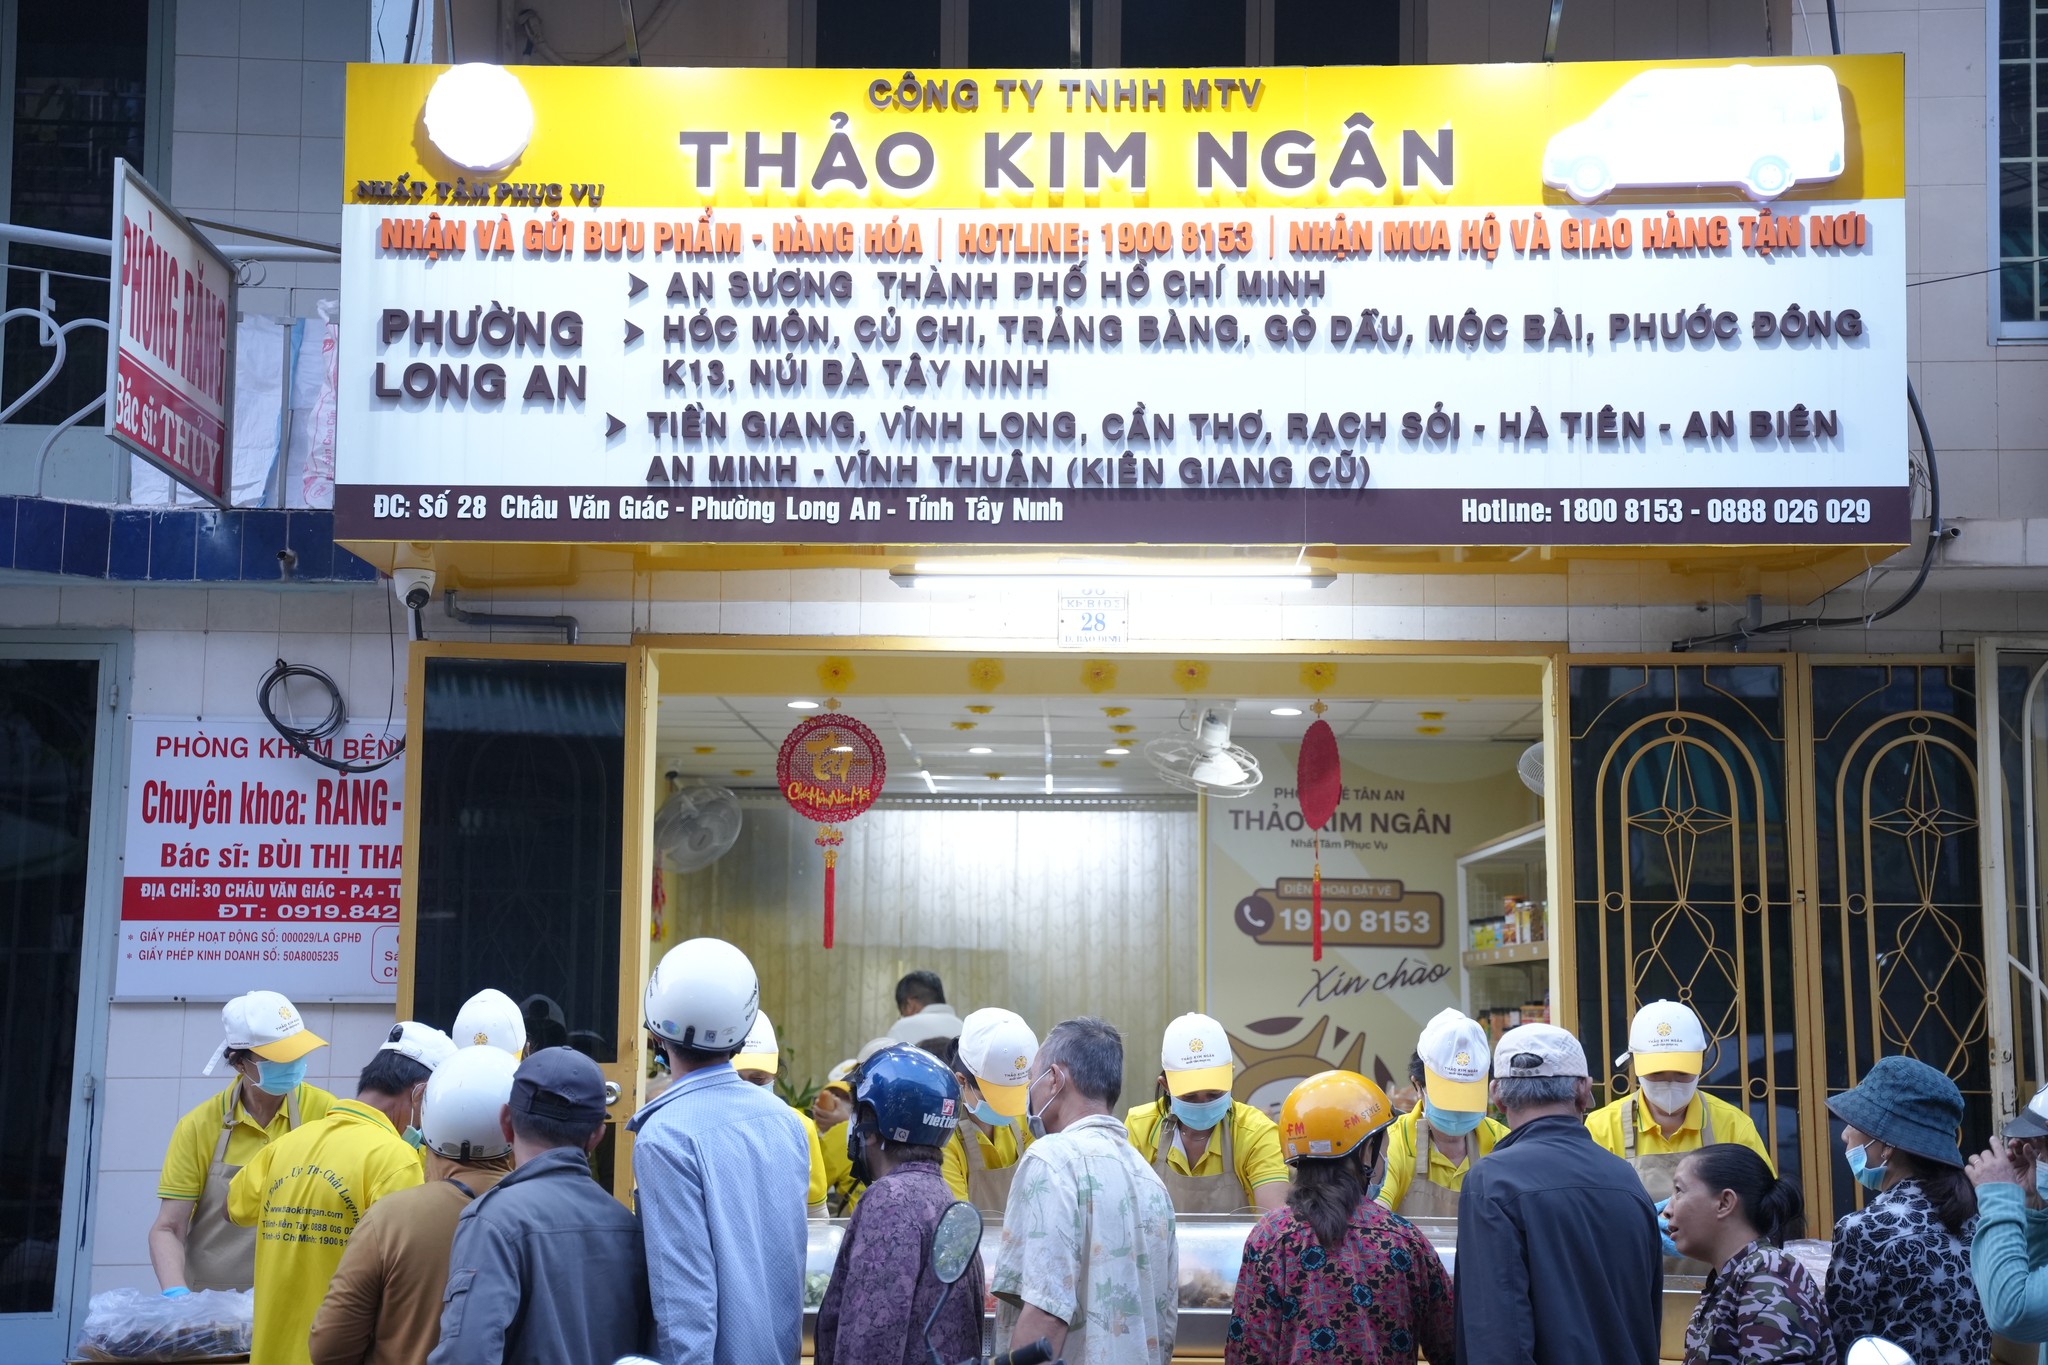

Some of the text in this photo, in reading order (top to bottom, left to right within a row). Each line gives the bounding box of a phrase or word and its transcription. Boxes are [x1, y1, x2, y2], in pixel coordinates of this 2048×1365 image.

[868, 71, 1262, 112] CÔNG TY TNHH MTV
[679, 111, 1454, 190] THẢO KIM NGÂN
[356, 172, 605, 206] NHẤT TÂM PHỤC VỤ
[381, 205, 1866, 260] NHẬN VÀ GỬI BƯU PHẨM HÀNG HÓA HOTLINE: 1900 8153 NHẬN MUA HỘ VÀ GIAO HÀNG TẬN NƠI
[665, 258, 1326, 300] AN SƯƠNG THÀNH PHỐ HỒ CHÍ MINH
[120, 210, 226, 407] PHÒNG RĂNG
[382, 300, 584, 347] PHƯỜNG
[664, 303, 1863, 349] HÓC MÔN, CỦ CHI, TRẢNG BÀNG, GÒ DẦU, MỘC BÀI, PHƯỚC ĐÔNG
[375, 362, 586, 401] LONG AN
[662, 352, 1049, 392] K13, NÚI BÀ TÂY NINH
[115, 373, 139, 435] Bác
[160, 405, 221, 487] THỦY
[647, 401, 1838, 446] TIỀN GIANG, VĨNH LONG, CẦN THƠ, RẠCH SỎI HÀ TIÊN AN BIÊN
[646, 449, 1371, 490] AN MINH VĨNH THUẬN (KIÊN GIANG CŨ)
[374, 494, 411, 519] ĐC:
[418, 490, 451, 519] Số
[457, 495, 487, 519] 28
[500, 495, 558, 519] Châu
[569, 495, 610, 520] Văn
[691, 494, 775, 524] Phường
[786, 497, 840, 524] Long
[850, 497, 881, 521] An
[906, 494, 953, 521] Tỉnh
[965, 496, 1004, 524] Tây
[1461, 498, 1871, 523] Hotline: 1800 8153 0888 026 029
[1081, 612, 1105, 631] 28
[156, 731, 333, 760] PHÒNG KHM
[142, 769, 388, 830] Chuyên khoa: RĂNG
[1353, 788, 1405, 801] TÂN AN
[1371, 808, 1452, 834] NGÂN
[161, 843, 209, 868] Bác
[219, 843, 249, 868] sĩ:
[258, 839, 301, 868] BÙI
[311, 844, 350, 874] THỊ
[1344, 840, 1371, 850] Phục
[1374, 841, 1388, 851] Vụ
[141, 879, 373, 900] ĐỊA CHỈ: 30 CHÂU VĂN GIÁC P.4
[218, 904, 267, 918] ĐT:
[1359, 909, 1430, 934] 8153
[140, 927, 362, 944] GIẤY PHÉP HOẠT ĐỘNG SỐ: 000029/LA GPHĐ
[138, 946, 339, 961] GIẤY PHÉP KINH DOANH SỐ: 50A8005235
[1298, 957, 1452, 1007] Xin chào
[1287, 1122, 1305, 1136] FM
[1343, 1103, 1381, 1129] FM STYLE
